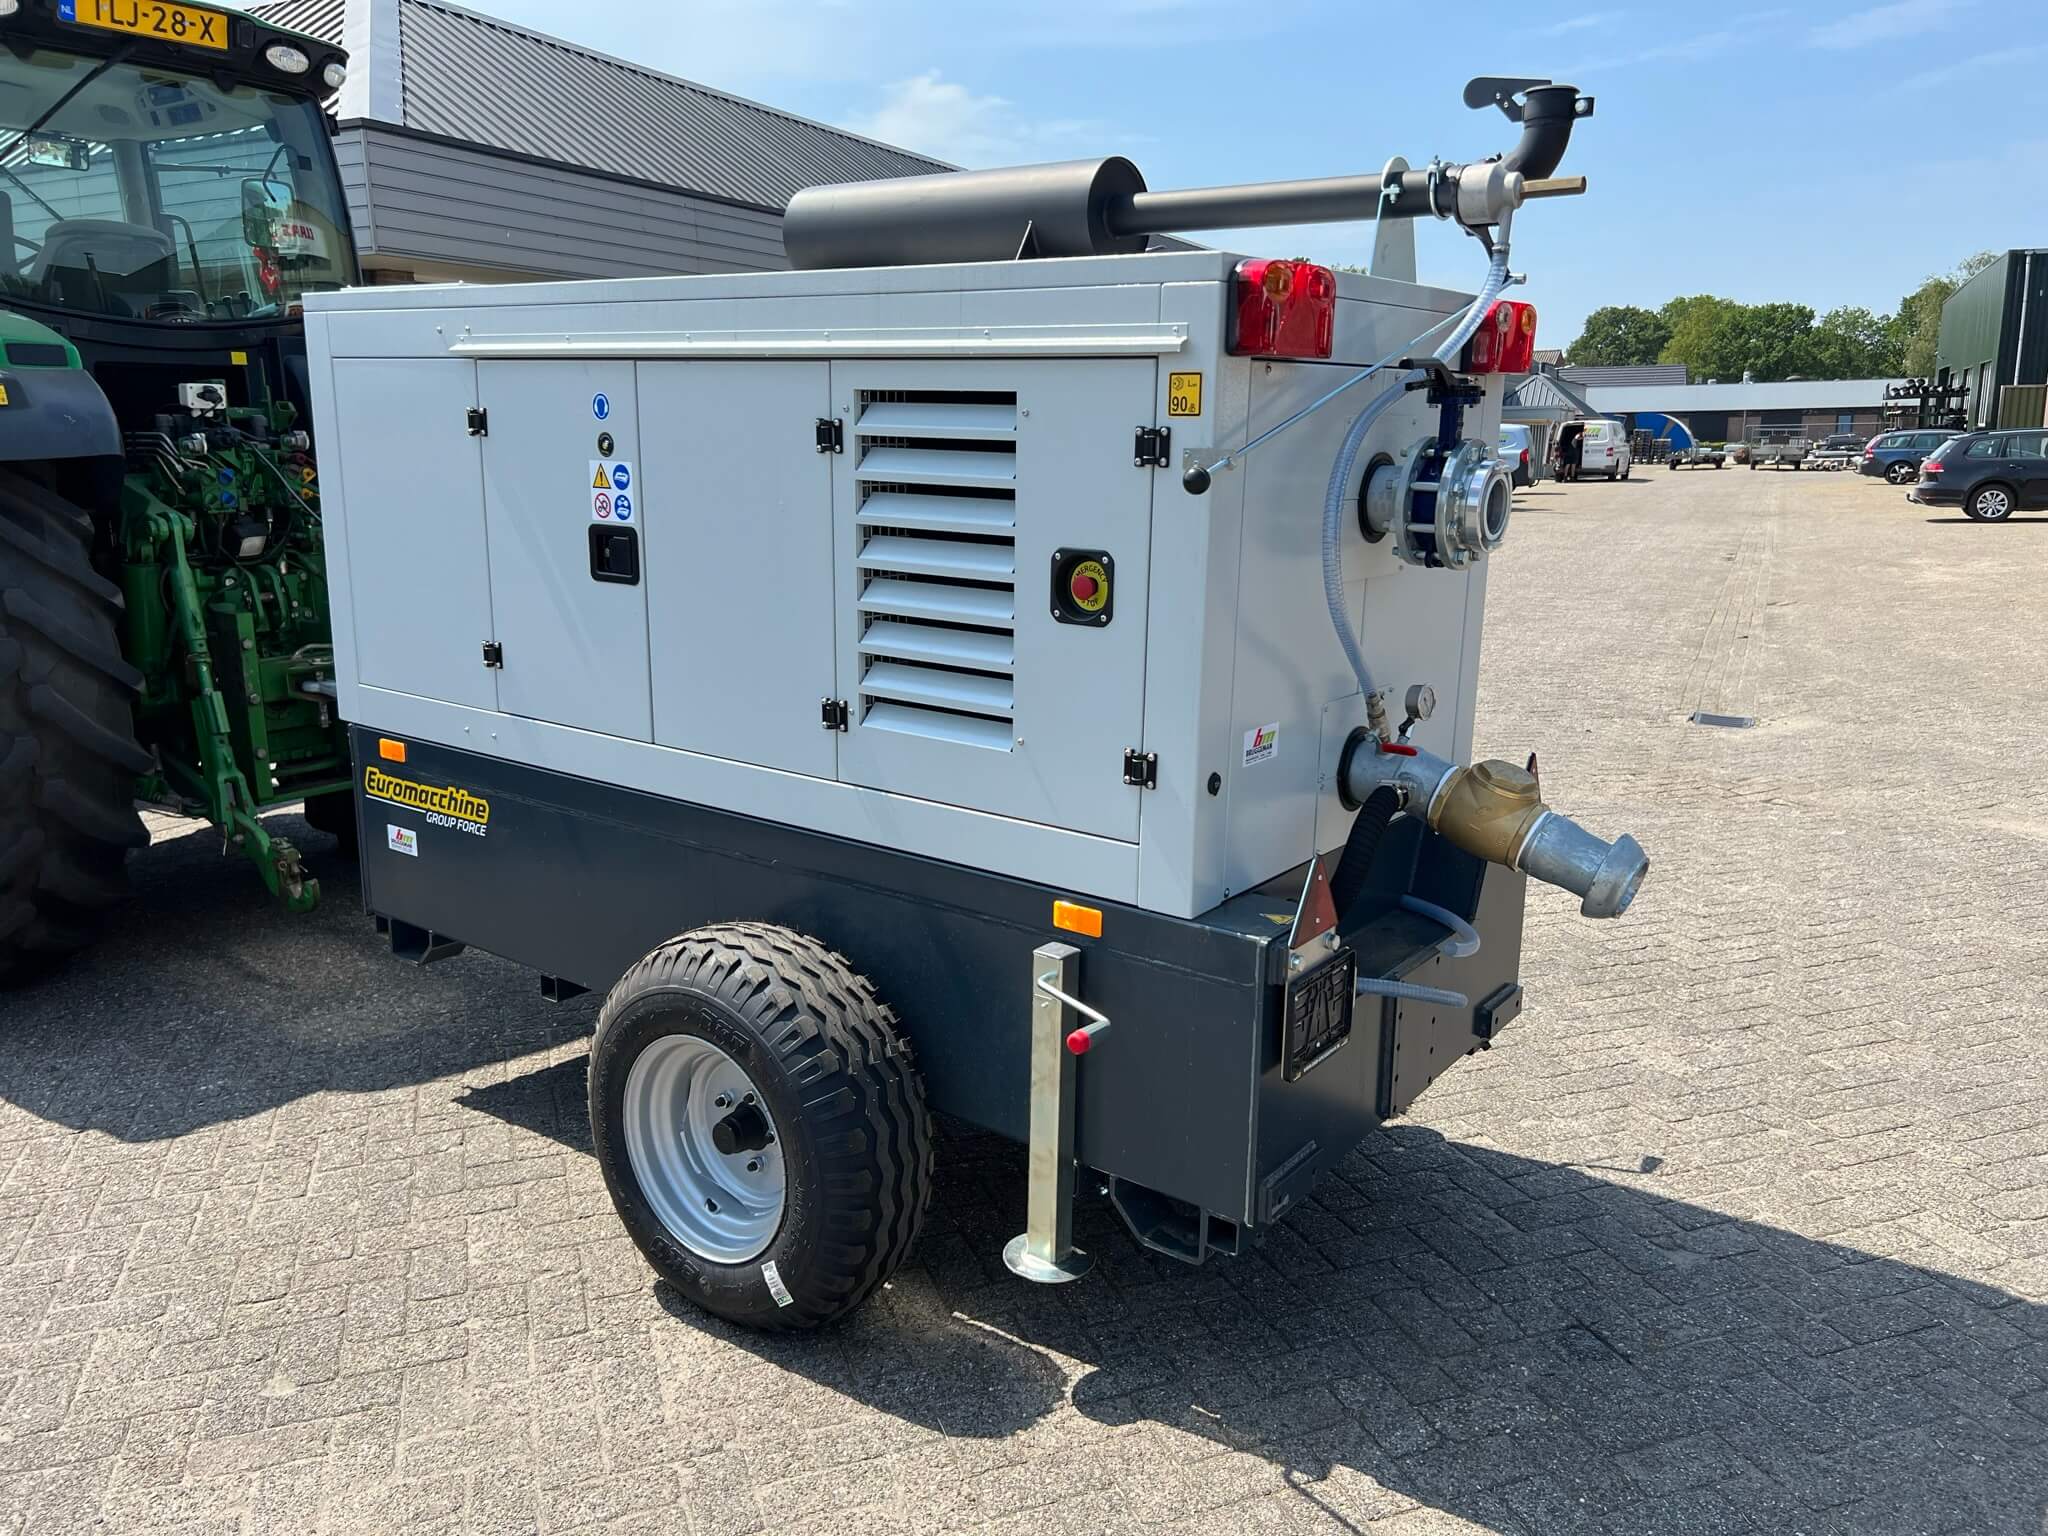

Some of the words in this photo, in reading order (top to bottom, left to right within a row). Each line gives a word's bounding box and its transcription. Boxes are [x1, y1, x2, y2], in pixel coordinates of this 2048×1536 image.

[1171, 396, 1187, 412] 90
[366, 768, 487, 820] Euromacchine
[426, 811, 456, 828] GROUP
[456, 819, 487, 836] FORCE
